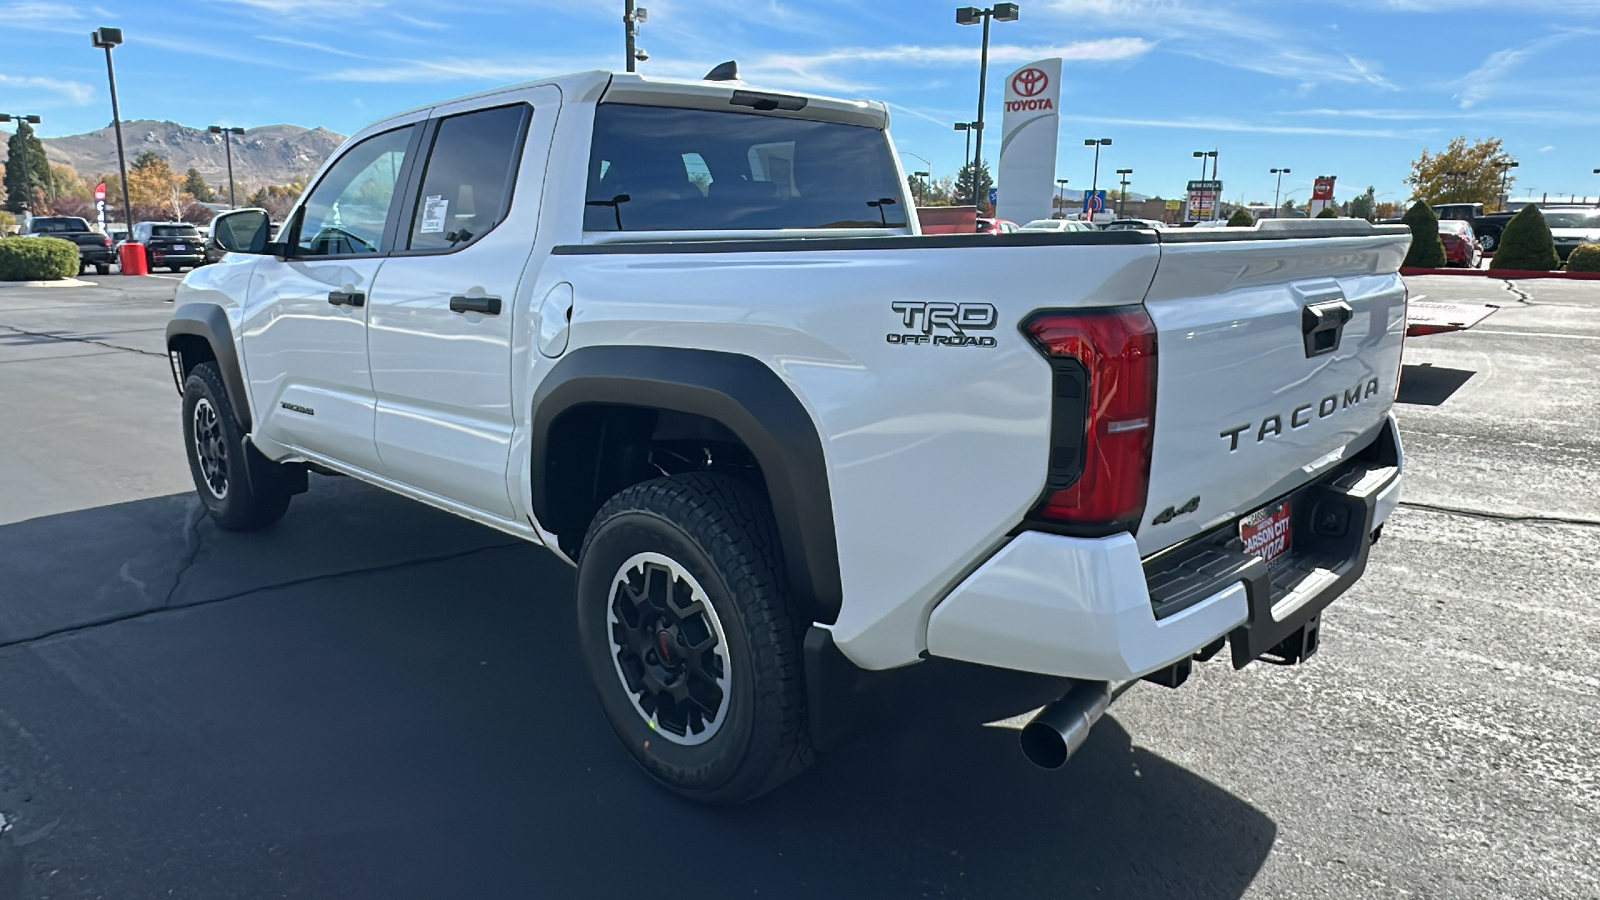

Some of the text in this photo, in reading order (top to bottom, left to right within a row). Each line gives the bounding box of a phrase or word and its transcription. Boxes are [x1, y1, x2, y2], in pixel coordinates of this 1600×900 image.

[1005, 98, 1053, 112] TOYOTA
[892, 301, 999, 337] TRD
[886, 334, 998, 348] OFF ROAD
[1220, 377, 1378, 454] TACOMA
[1274, 517, 1290, 536] CITY
[1251, 535, 1285, 563] YOTA
